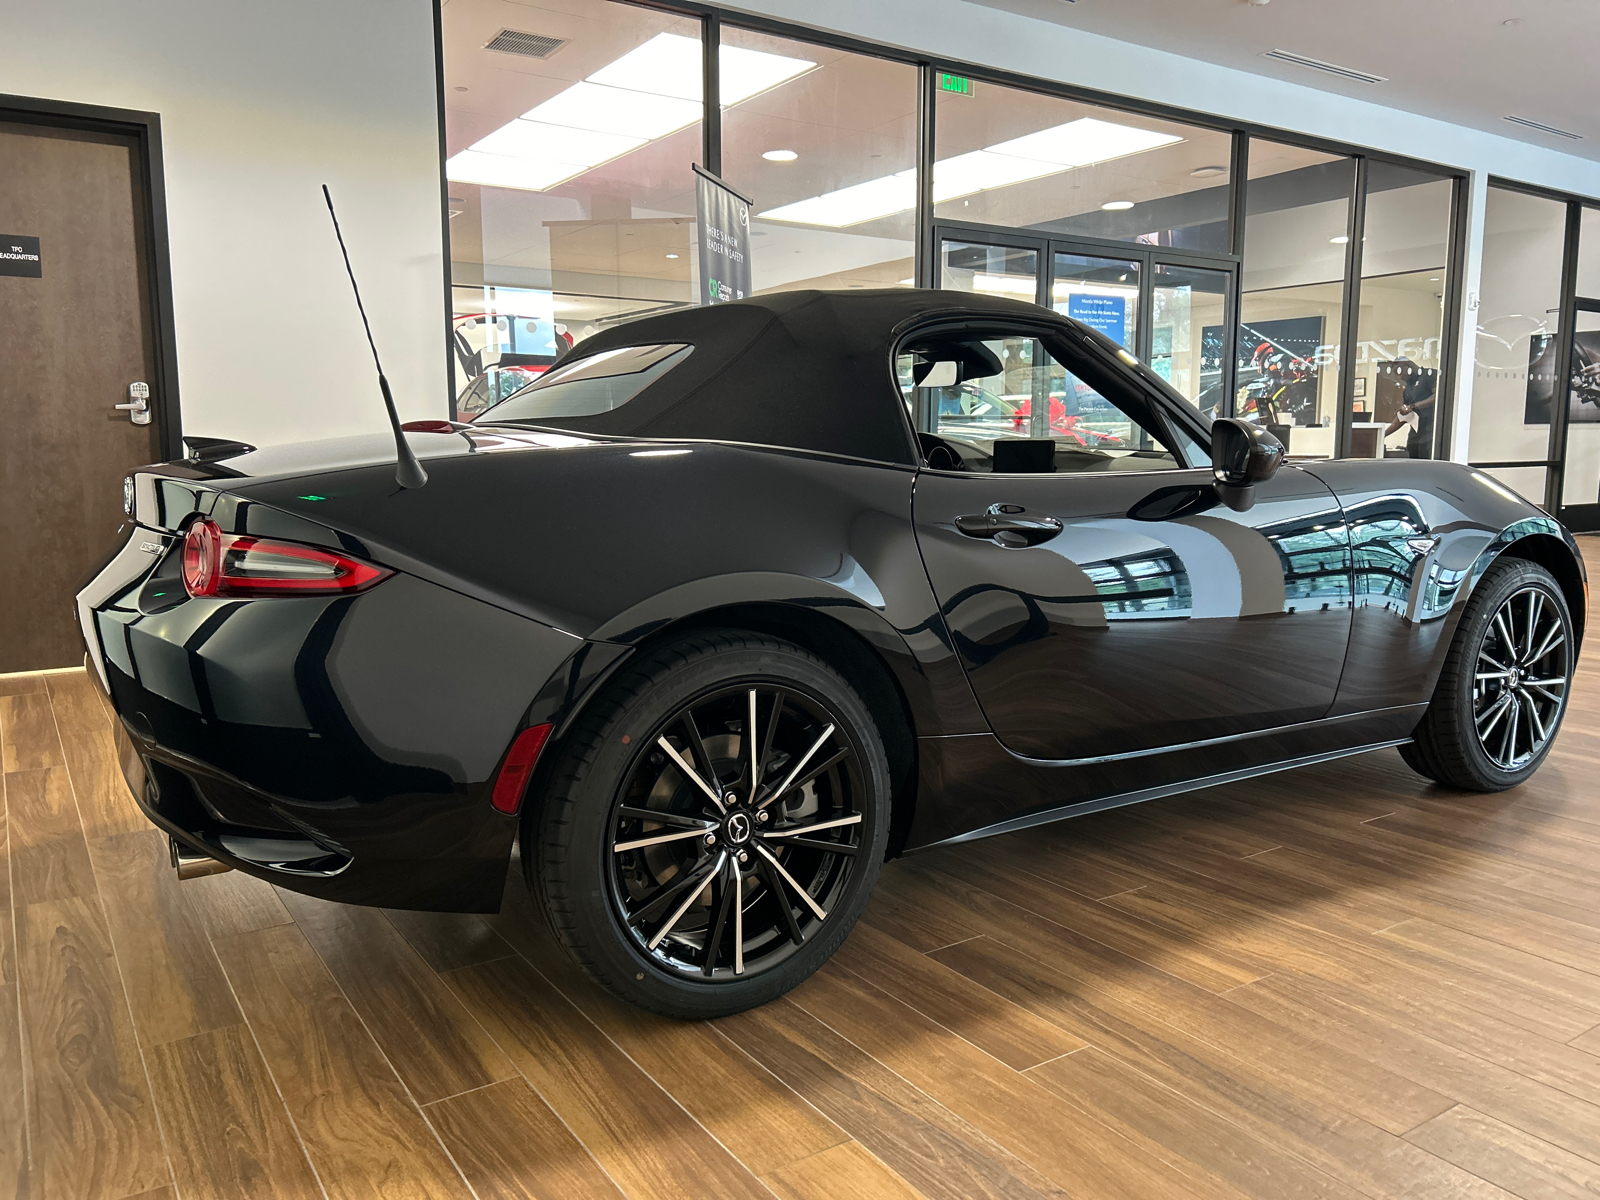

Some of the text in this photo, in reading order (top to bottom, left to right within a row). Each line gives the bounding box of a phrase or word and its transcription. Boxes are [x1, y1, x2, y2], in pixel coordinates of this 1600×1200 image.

[943, 74, 967, 93] EXIT
[706, 223, 724, 241] THERE'S
[728, 235, 738, 248] NEW
[0, 252, 39, 261] EADQUARTERS
[707, 238, 723, 254] LEADER
[729, 248, 744, 263] SAFETY
[709, 277, 718, 298] CR
[718, 281, 732, 294] Consumer
